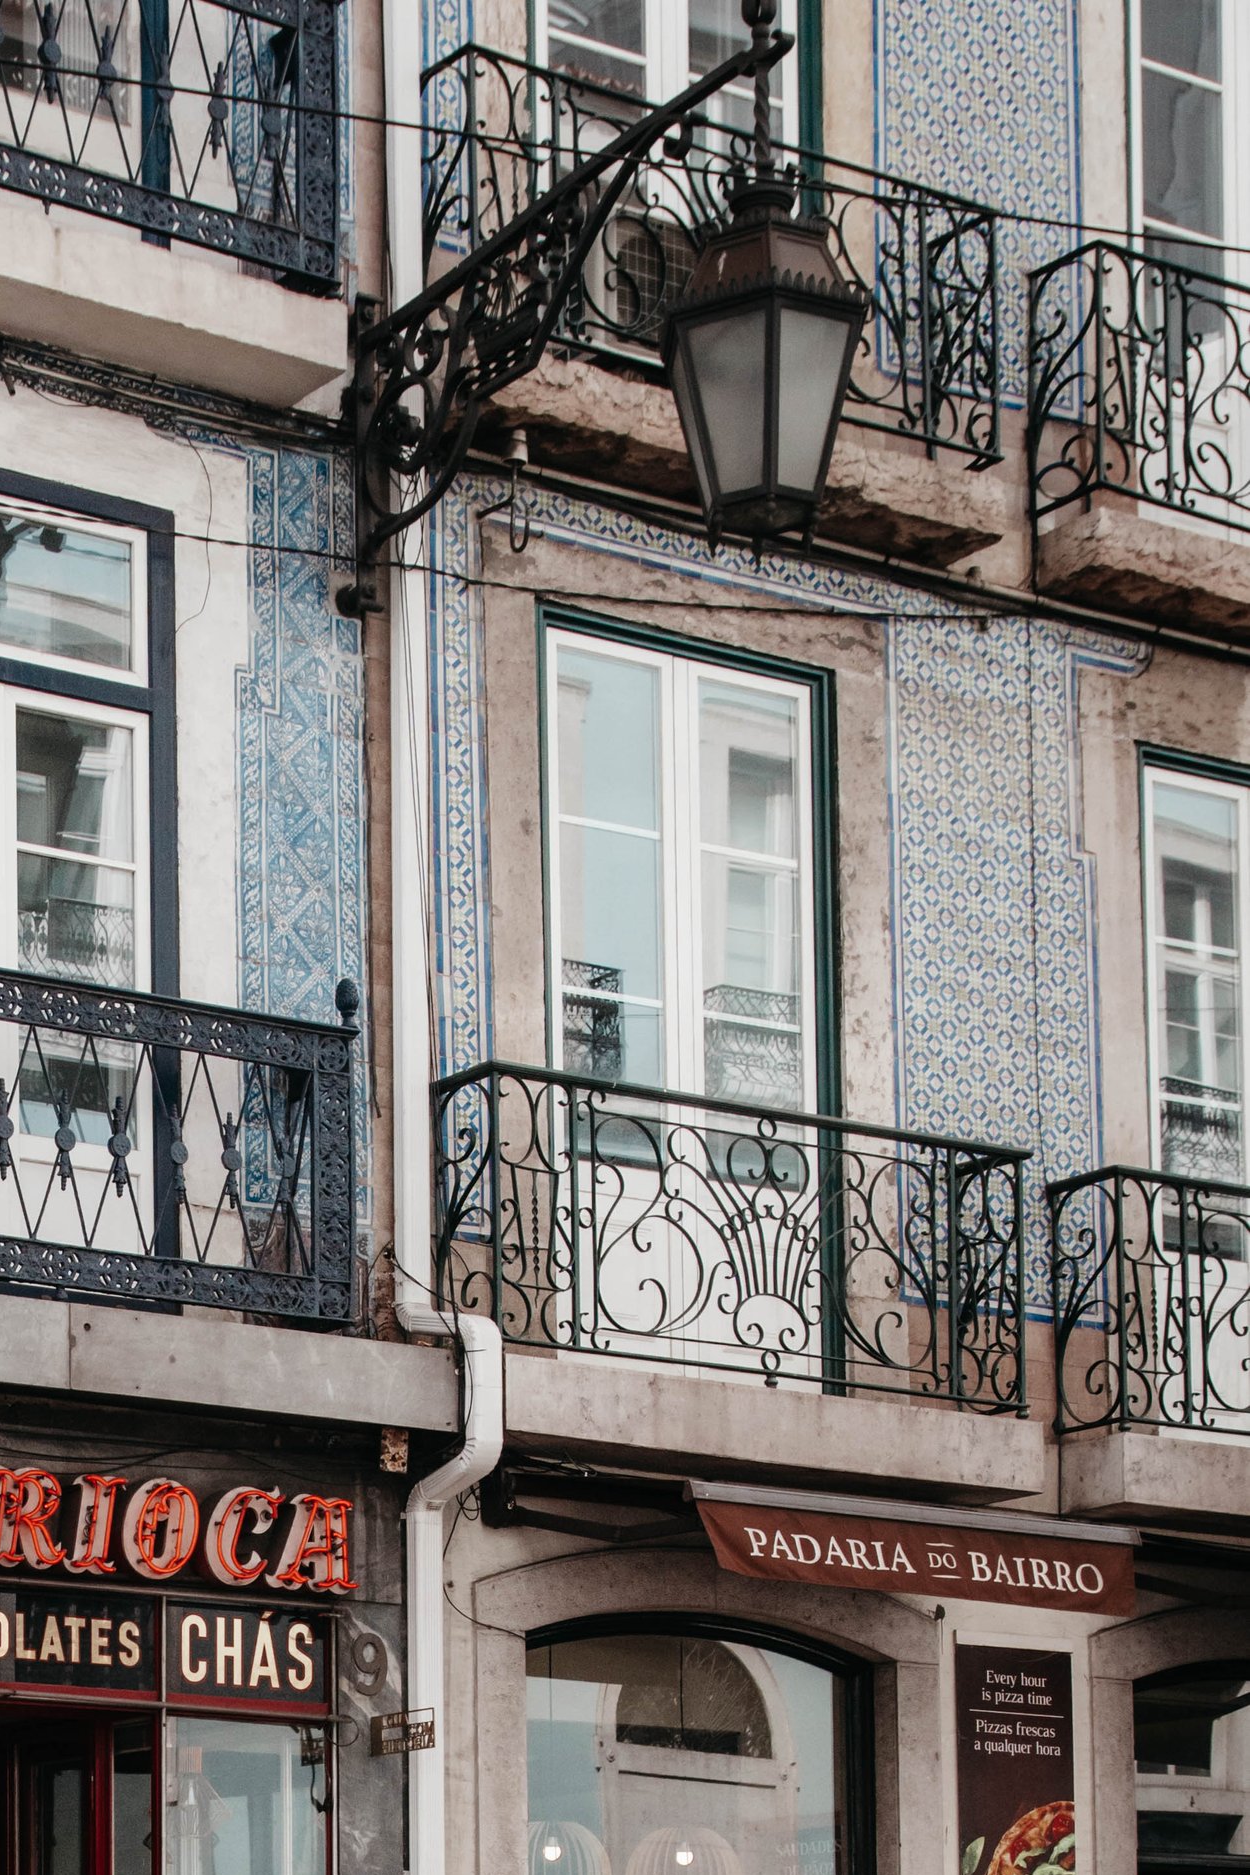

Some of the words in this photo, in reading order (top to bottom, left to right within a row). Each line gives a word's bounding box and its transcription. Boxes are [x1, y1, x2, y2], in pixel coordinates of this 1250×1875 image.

[744, 1526, 917, 1575] PADARIA
[928, 1552, 958, 1571] DO
[970, 1551, 1105, 1595] BAIRRO
[180, 1610, 314, 1690] CHÁS
[352, 1632, 389, 1696] 9
[986, 1669, 1017, 1688] Every
[1020, 1672, 1048, 1688] hour
[981, 1687, 992, 1701] is
[995, 1689, 1024, 1705] pizza
[1027, 1691, 1053, 1706] time
[975, 1719, 1013, 1735] Pizzas
[1016, 1721, 1056, 1738] frescas
[974, 1740, 981, 1751] a
[984, 1738, 1032, 1757] qualquer
[1036, 1741, 1062, 1757] hora
